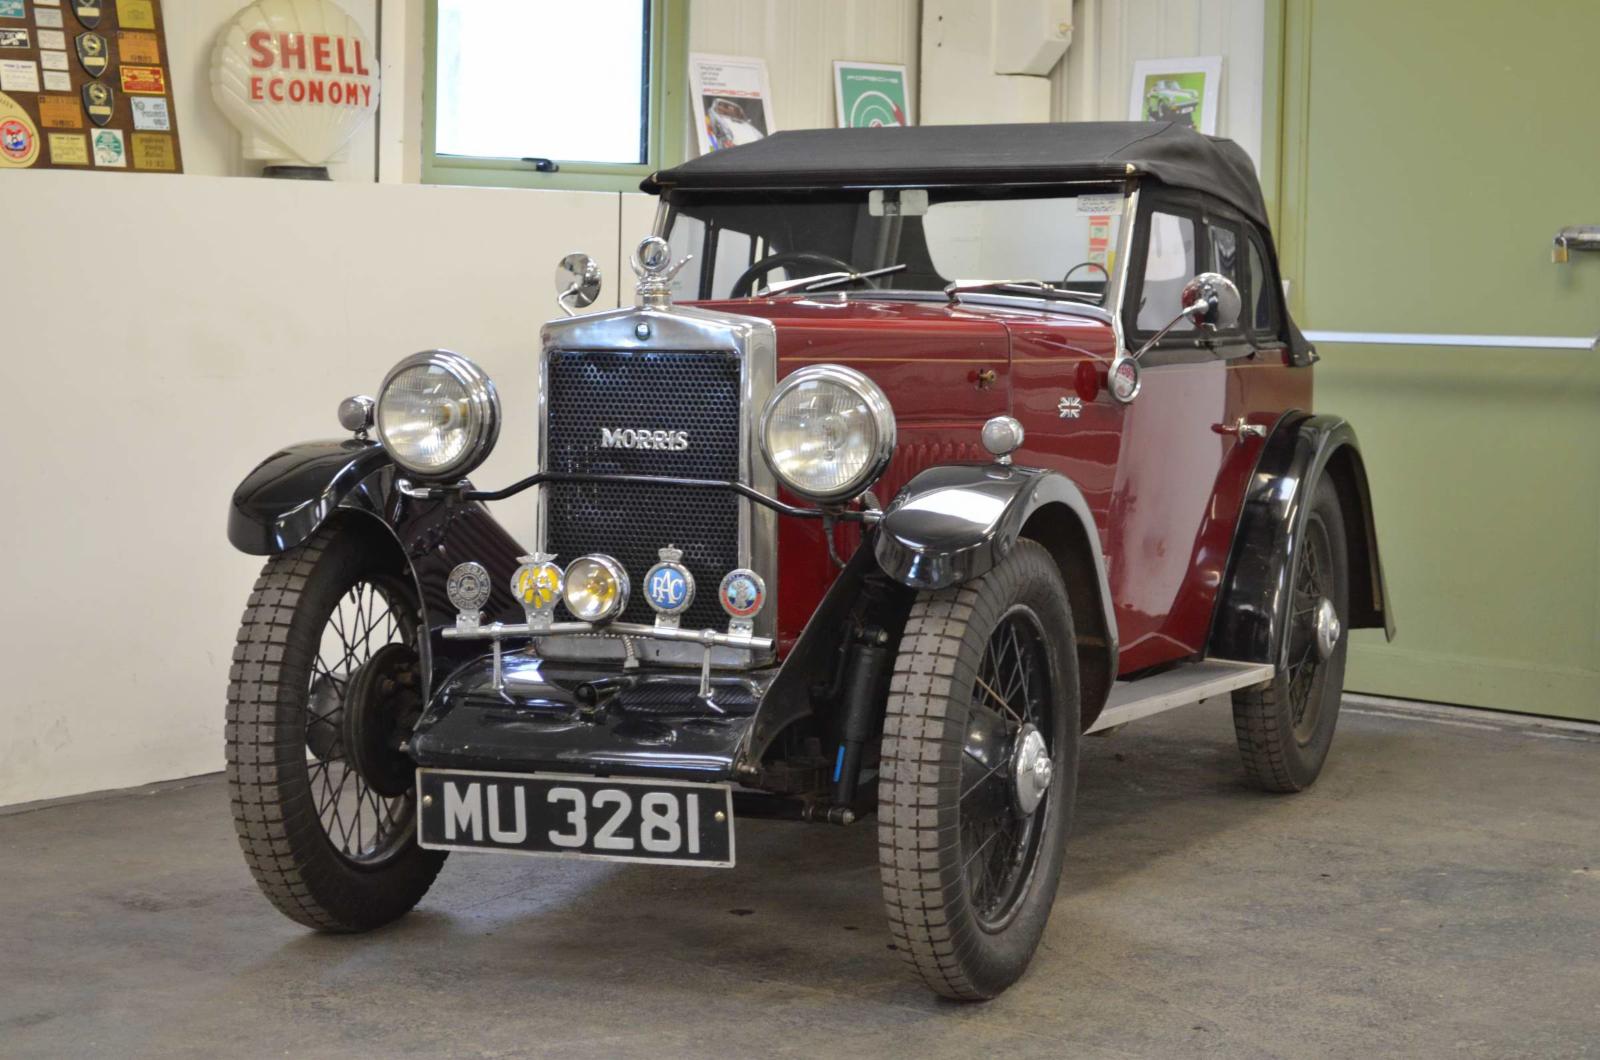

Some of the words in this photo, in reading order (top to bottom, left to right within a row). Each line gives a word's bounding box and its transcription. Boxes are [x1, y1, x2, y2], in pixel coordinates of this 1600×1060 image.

[249, 29, 369, 76] SHELL
[250, 77, 371, 107] ECONOMY
[600, 428, 688, 451] MORRIS
[652, 570, 684, 604] RAC
[443, 782, 527, 844] MU
[547, 787, 700, 854] 3281
